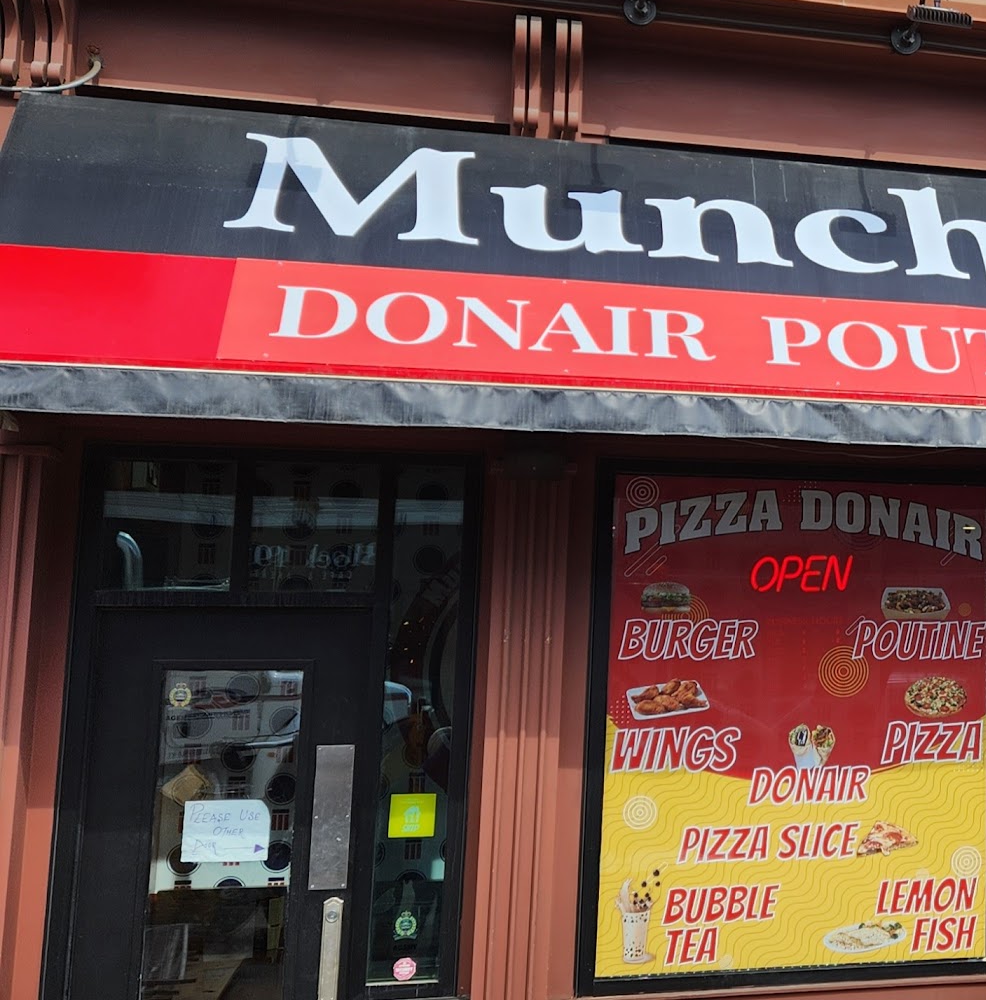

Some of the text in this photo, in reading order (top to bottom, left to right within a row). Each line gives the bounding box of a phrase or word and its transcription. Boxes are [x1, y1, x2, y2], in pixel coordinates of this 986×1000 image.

[269, 284, 716, 361] DONAIR
[624, 489, 983, 561] PIZZA DONAIR
[750, 555, 853, 592] OPEN
[617, 618, 760, 661] BURGER
[609, 726, 741, 773] WINGS
[881, 720, 984, 764] PIZZA
[747, 765, 871, 807] DONAIR
[189, 803, 261, 823] PLEASE USE
[213, 826, 245, 839] OTHER
[677, 822, 859, 864] PIZZA SLICE
[662, 884, 780, 925] BUBBLE
[876, 877, 978, 917] LEMON
[663, 925, 719, 967] TEA
[911, 916, 977, 954] FISH
